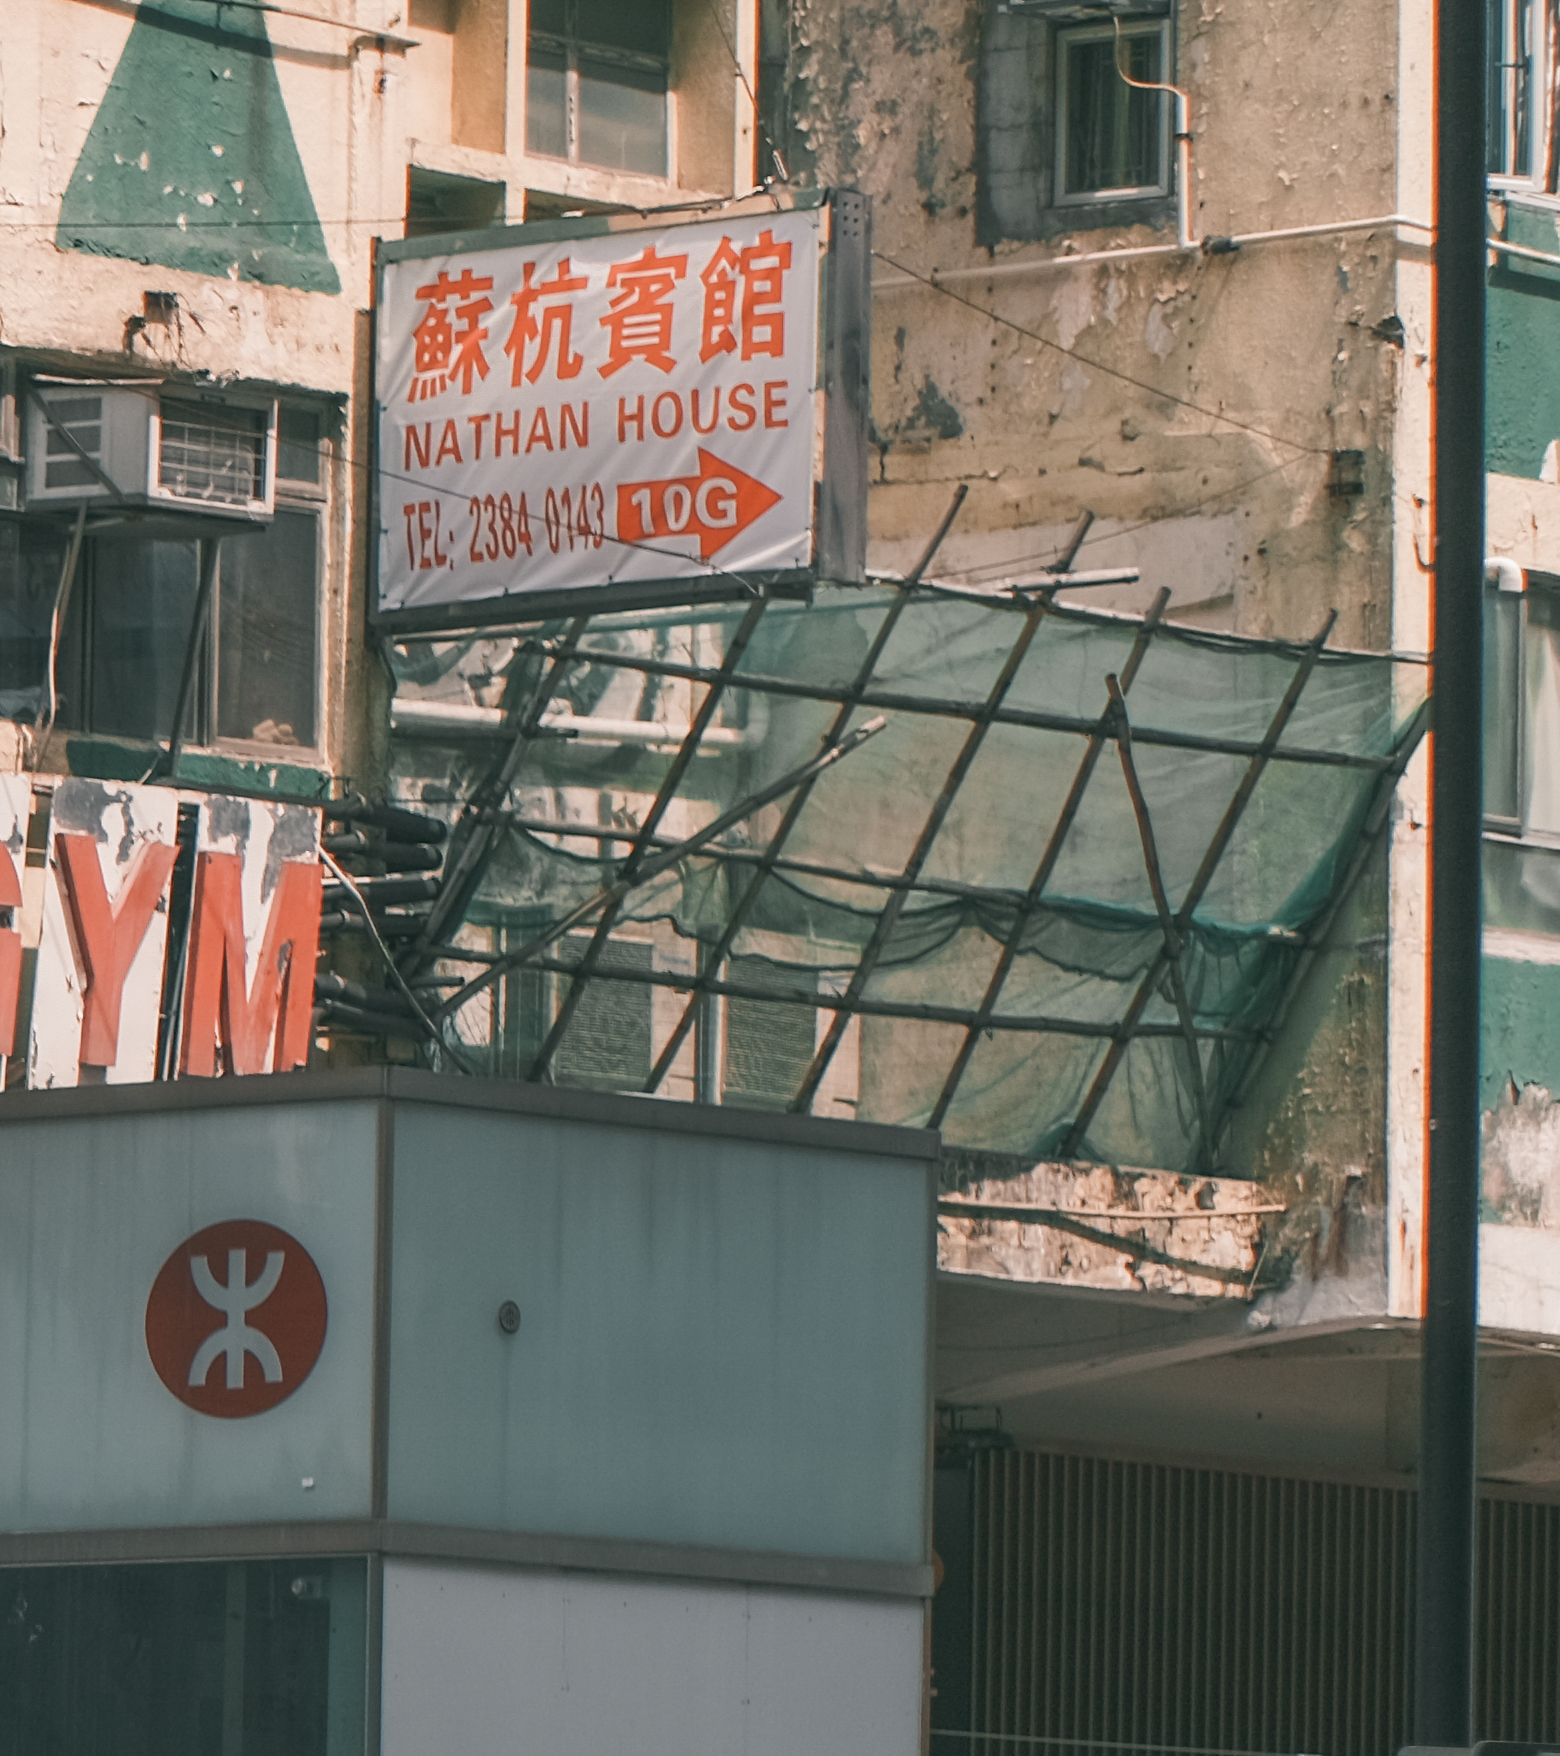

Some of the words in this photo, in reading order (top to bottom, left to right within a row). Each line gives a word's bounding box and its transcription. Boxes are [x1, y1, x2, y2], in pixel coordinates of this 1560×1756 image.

[407, 229, 792, 403] 蘇杭賓館
[403, 402, 590, 472] NATHAN
[619, 381, 789, 443] HOUSE
[469, 492, 533, 563] 2384
[545, 482, 605, 554] 0143
[631, 477, 738, 534] 10G
